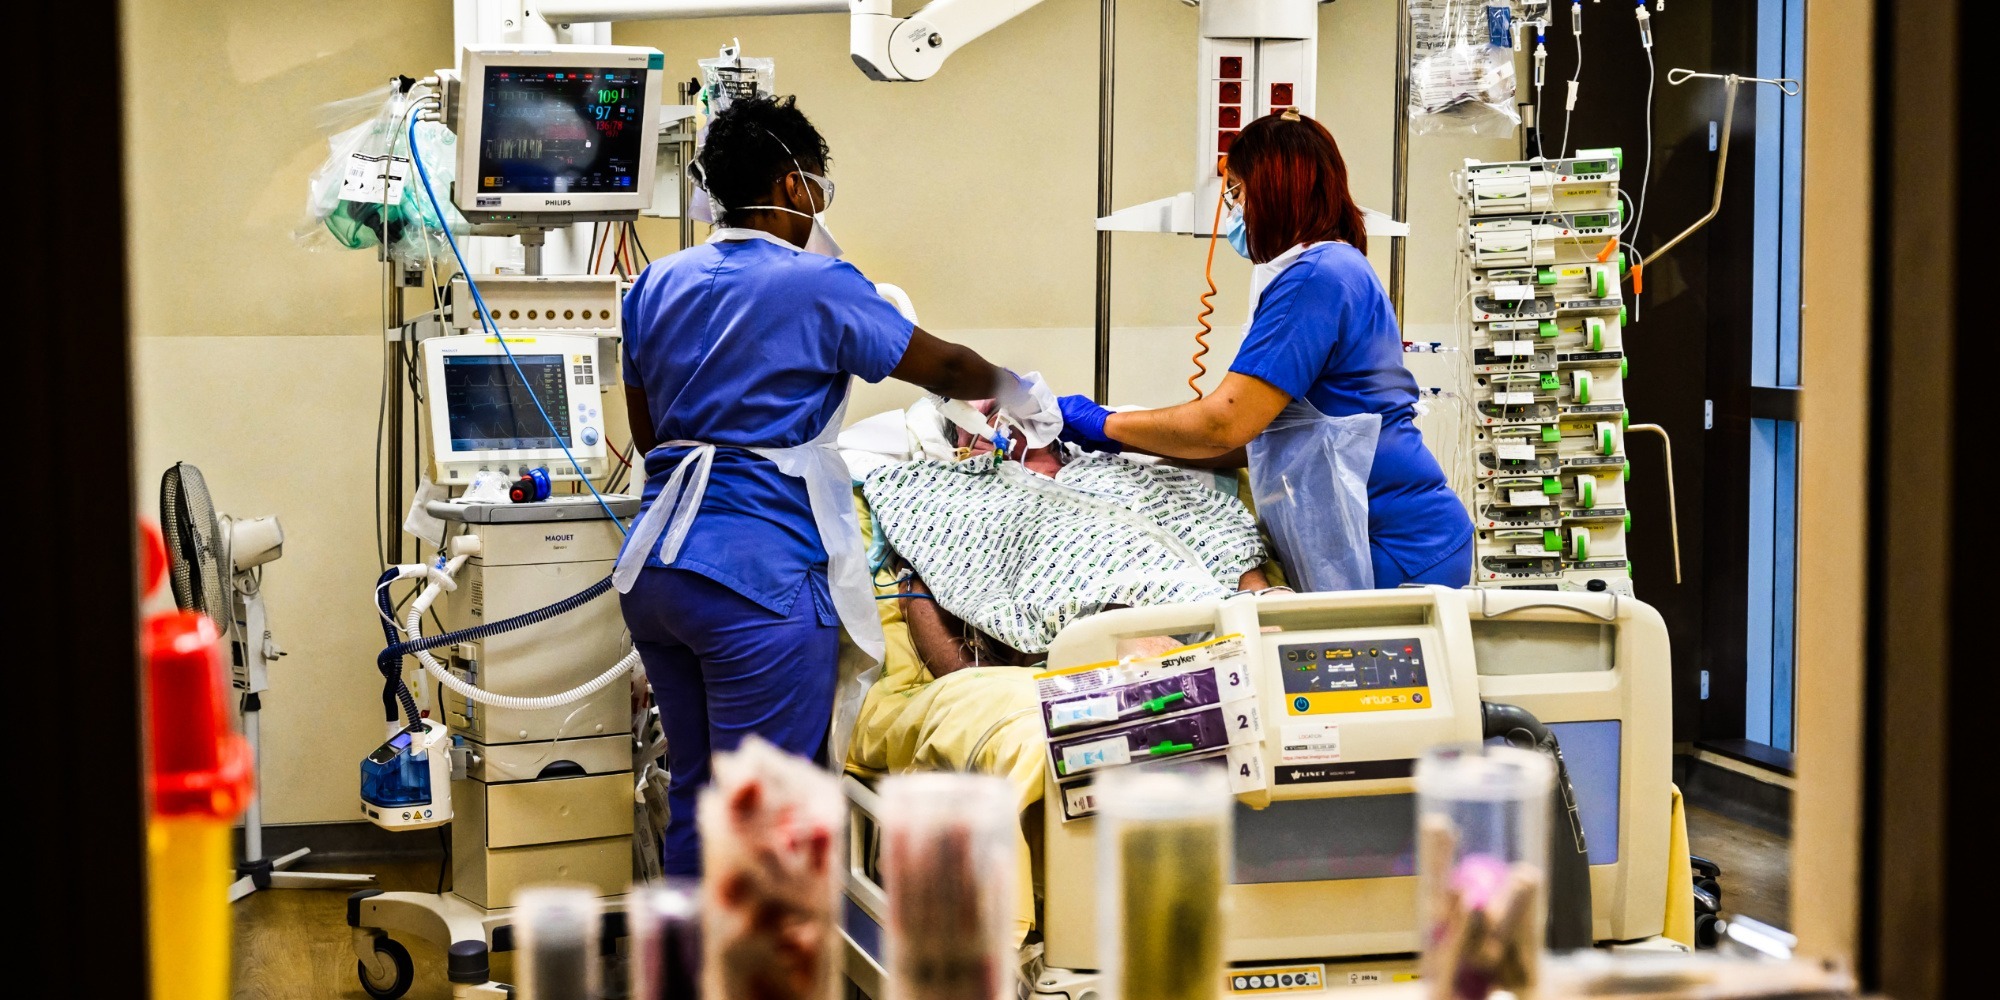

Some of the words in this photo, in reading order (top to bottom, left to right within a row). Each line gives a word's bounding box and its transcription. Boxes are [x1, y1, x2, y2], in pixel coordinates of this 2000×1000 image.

[597, 89, 619, 104] 109
[595, 106, 611, 120] 97
[1161, 655, 1197, 669] stryker
[1229, 672, 1240, 687] 3
[1359, 694, 1407, 705] virtuoso
[1237, 714, 1249, 730] 2
[1240, 763, 1250, 777] 4
